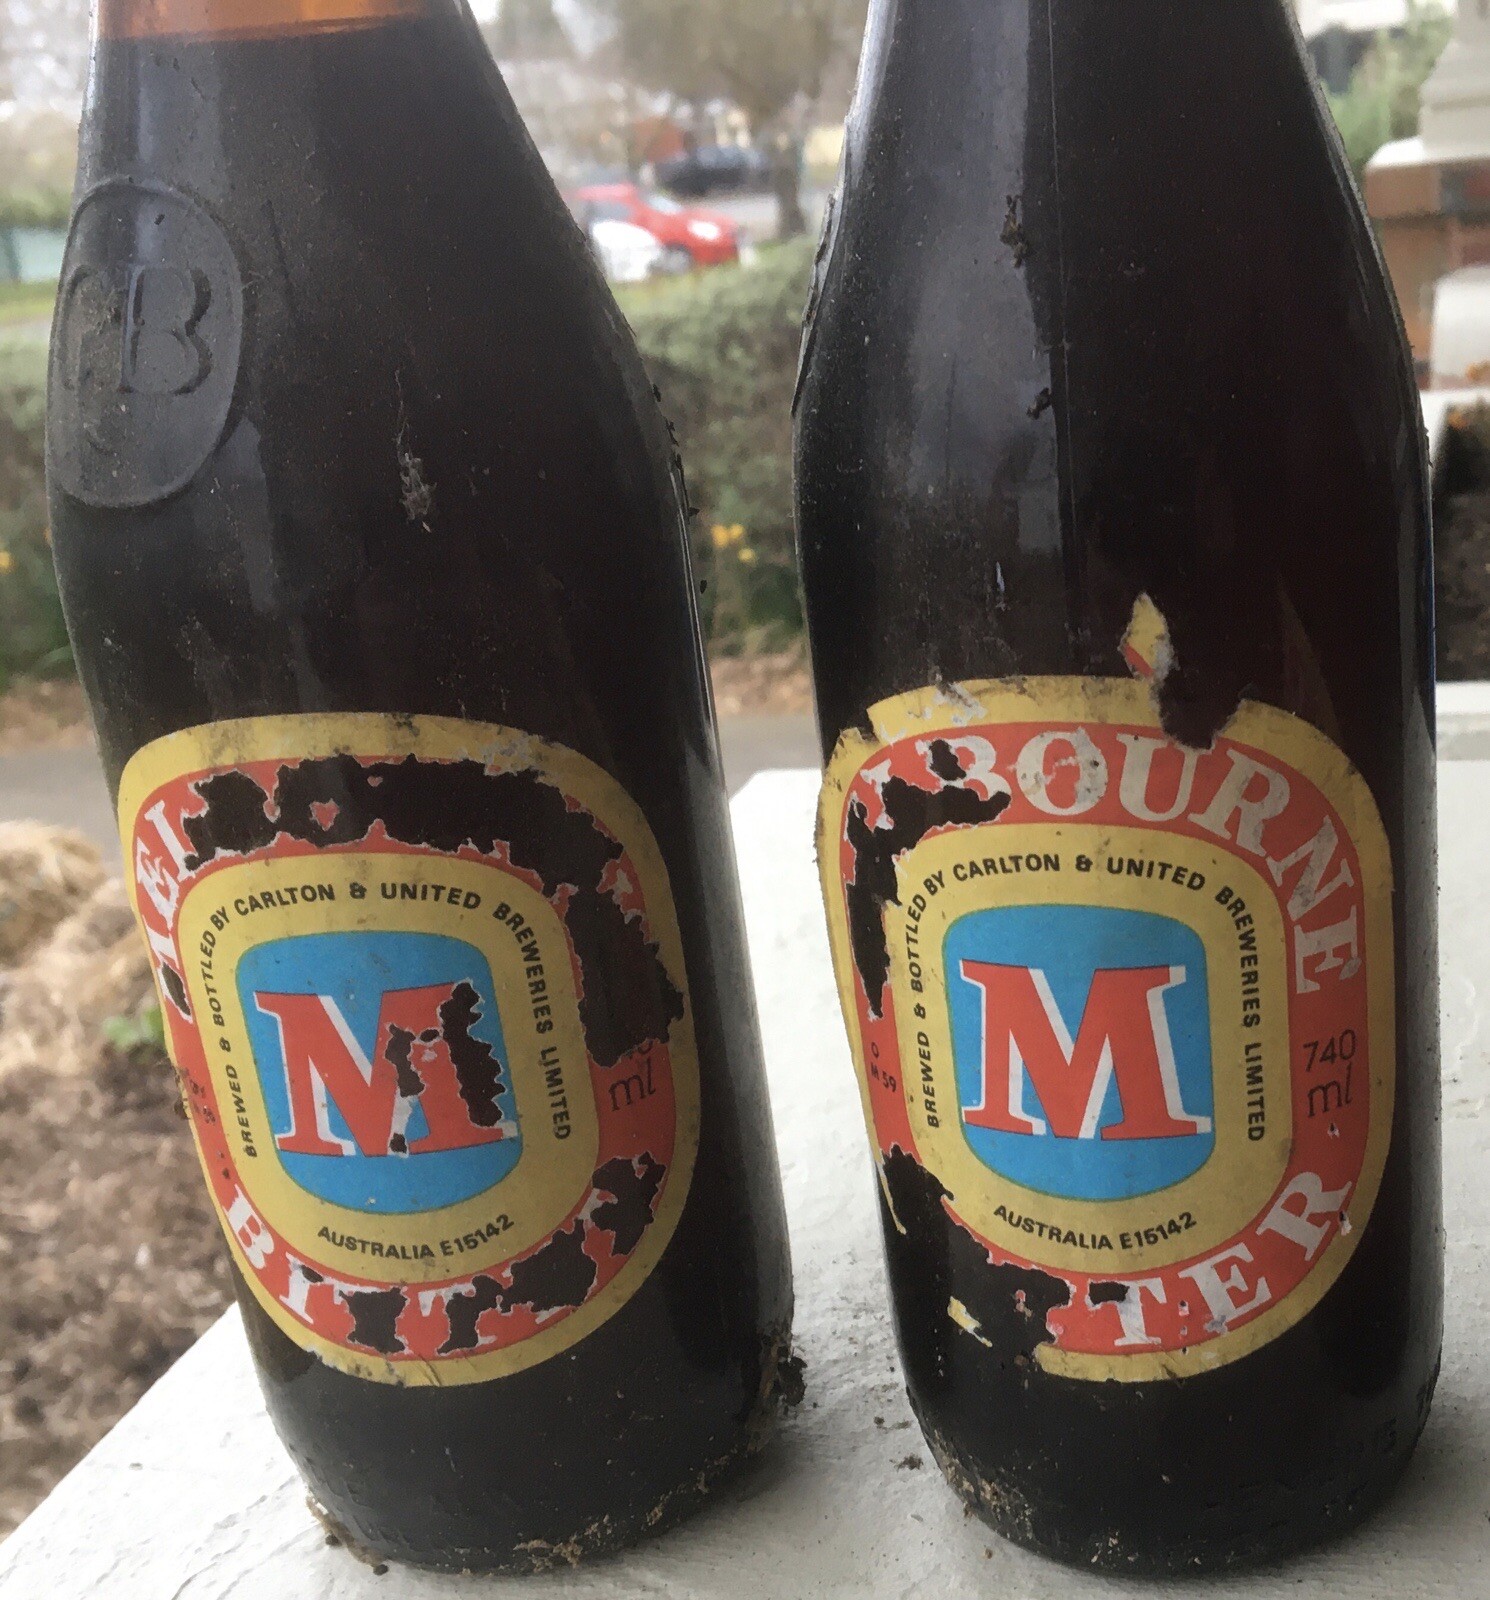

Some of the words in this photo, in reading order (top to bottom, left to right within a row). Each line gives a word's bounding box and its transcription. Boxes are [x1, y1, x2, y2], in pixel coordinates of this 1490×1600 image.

[923, 870, 945, 896] BY
[952, 854, 1060, 882] CARLTON
[1075, 854, 1093, 873] &
[1107, 857, 1206, 891] UNITED
[234, 884, 335, 916] CARLTON
[350, 882, 367, 899] &
[381, 882, 481, 910] UNITED
[210, 906, 230, 931] BY
[906, 893, 927, 993] BOTTLED
[200, 930, 225, 1027] BOTTLED
[492, 902, 553, 1034] BREWERIES
[1214, 886, 1261, 1028] BREWERIES
[913, 1003, 926, 1019] &
[220, 1036, 231, 1052] &
[253, 977, 518, 1158] M
[958, 958, 1211, 1140] M
[1303, 1029, 1356, 1072] 740
[540, 1046, 571, 1140] LIMITED
[608, 1056, 656, 1111] ml
[917, 1031, 939, 1128] BREWED
[1245, 1042, 1265, 1141] LIMITED
[1308, 1062, 1353, 1117] ml
[226, 1065, 257, 1158] BREWED
[317, 1225, 435, 1260] AUSTRALIA
[440, 1213, 514, 1256] E15142
[993, 1205, 1113, 1250] AUSTRALIA
[1120, 1211, 1197, 1250] E15142
[1085, 1171, 1353, 1346] TER
